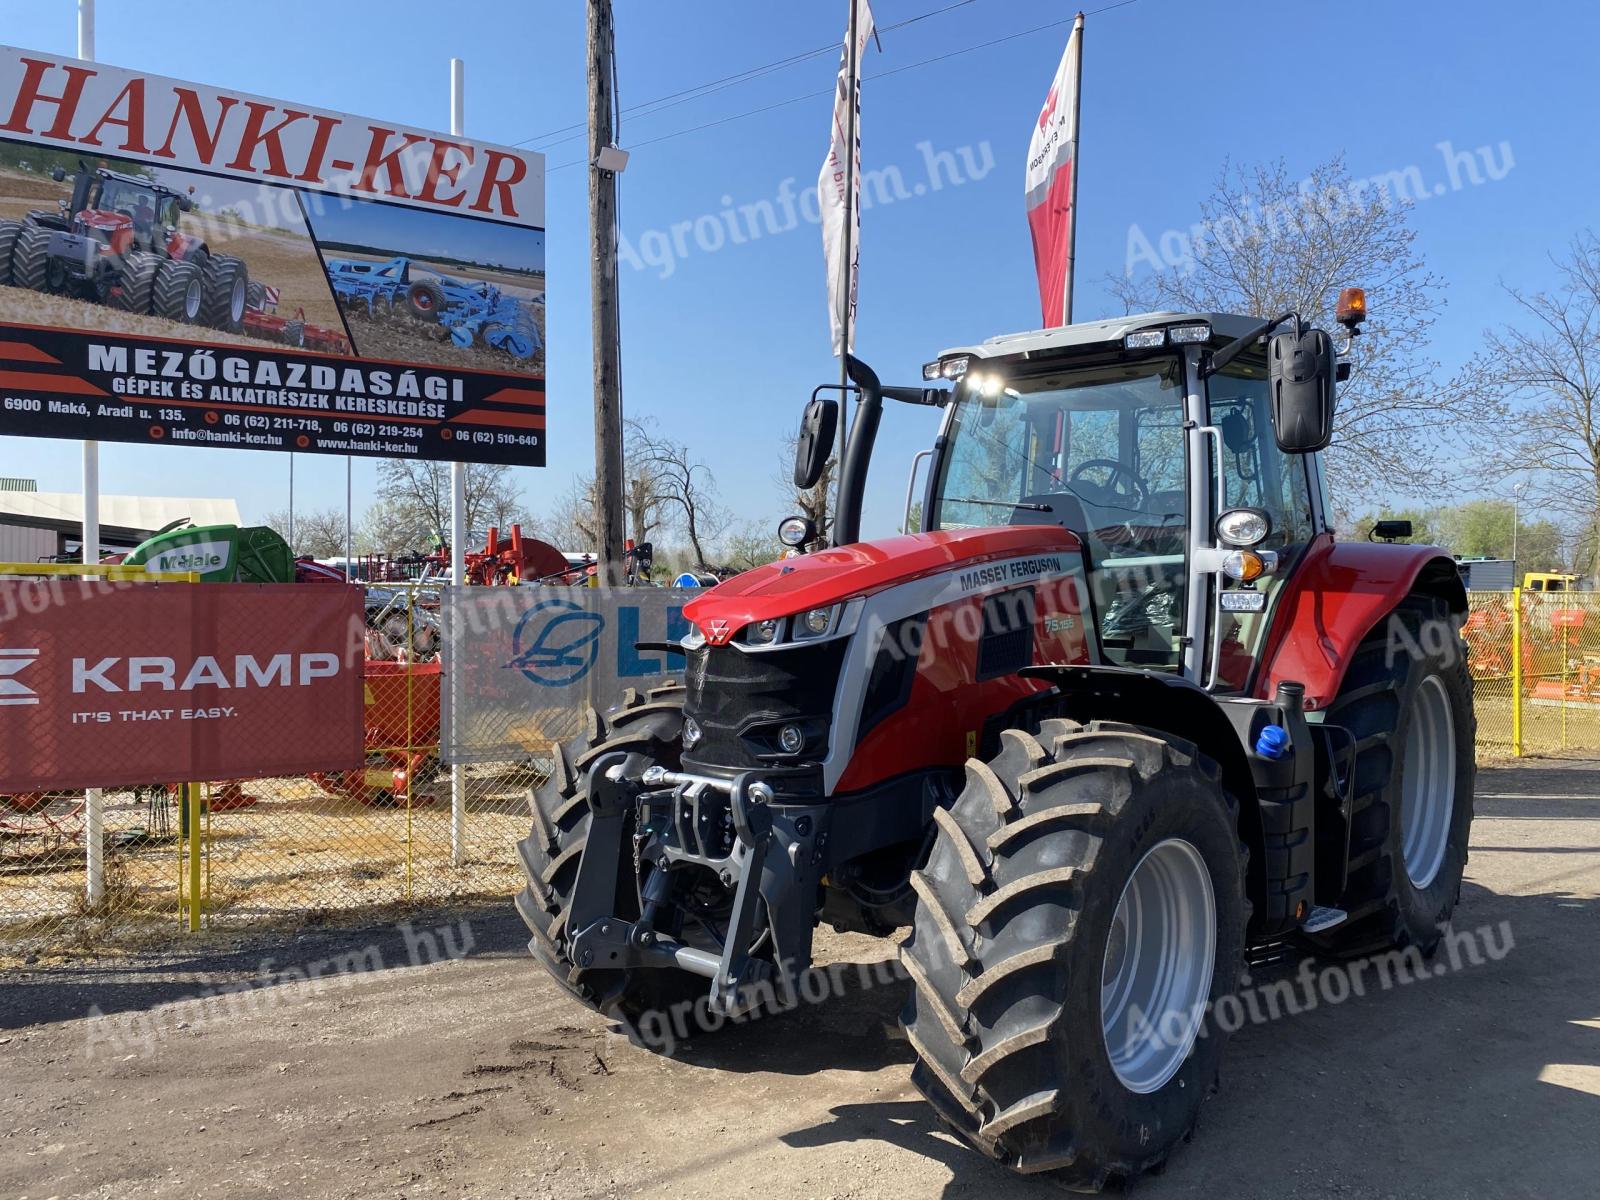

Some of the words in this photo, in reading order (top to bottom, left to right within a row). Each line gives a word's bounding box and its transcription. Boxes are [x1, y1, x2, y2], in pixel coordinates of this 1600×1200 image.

[2, 57, 528, 217] HANKI-KER
[87, 343, 464, 402] MEZŐGAZDASÁGI
[112, 376, 174, 397] GÉPEK
[181, 380, 203, 399] ÉS
[210, 384, 330, 410] ALKATRÉSZEK
[336, 395, 446, 419] KERESKEDÉSE
[4, 397, 41, 412] 6900
[48, 400, 91, 417] Makó,
[97, 404, 133, 418] Aradi
[139, 408, 152, 419] u.
[158, 408, 186, 422] 135.
[224, 413, 241, 426] 06
[244, 414, 270, 430] (62)
[273, 416, 322, 433] 211-718,
[333, 421, 348, 434] 06
[351, 421, 375, 437] (62)
[378, 424, 423, 439] 219-254
[172, 427, 282, 445] info@hanki-ker.hu
[317, 438, 418, 455] www.hanki-ker.hu
[456, 430, 470, 442] 06
[473, 430, 494, 445] (62)
[497, 432, 538, 447] 510-640
[960, 564, 1009, 591] MASSEY
[1011, 556, 1061, 579] FERGUSON
[72, 652, 340, 694] KRAMP
[118, 708, 174, 722] THAT
[181, 706, 239, 721] EASY.
